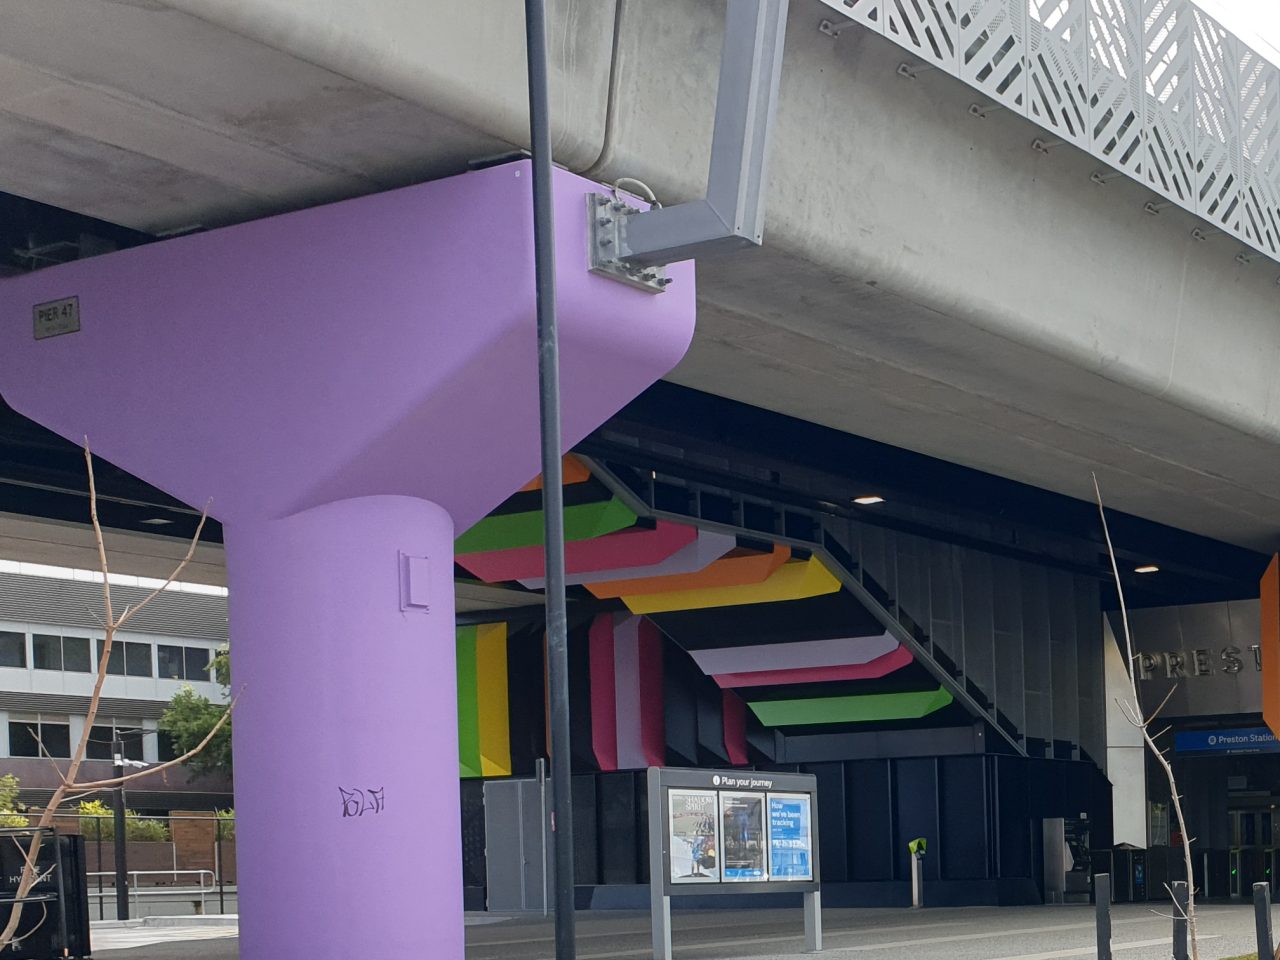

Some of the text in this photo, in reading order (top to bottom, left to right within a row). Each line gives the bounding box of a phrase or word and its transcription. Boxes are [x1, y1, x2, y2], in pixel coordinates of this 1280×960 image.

[38, 303, 74, 322] PIER 47
[1218, 735, 1248, 745] Preston
[721, 776, 773, 789] Plan your journey
[771, 801, 784, 809] How
[771, 819, 794, 829] tracking
